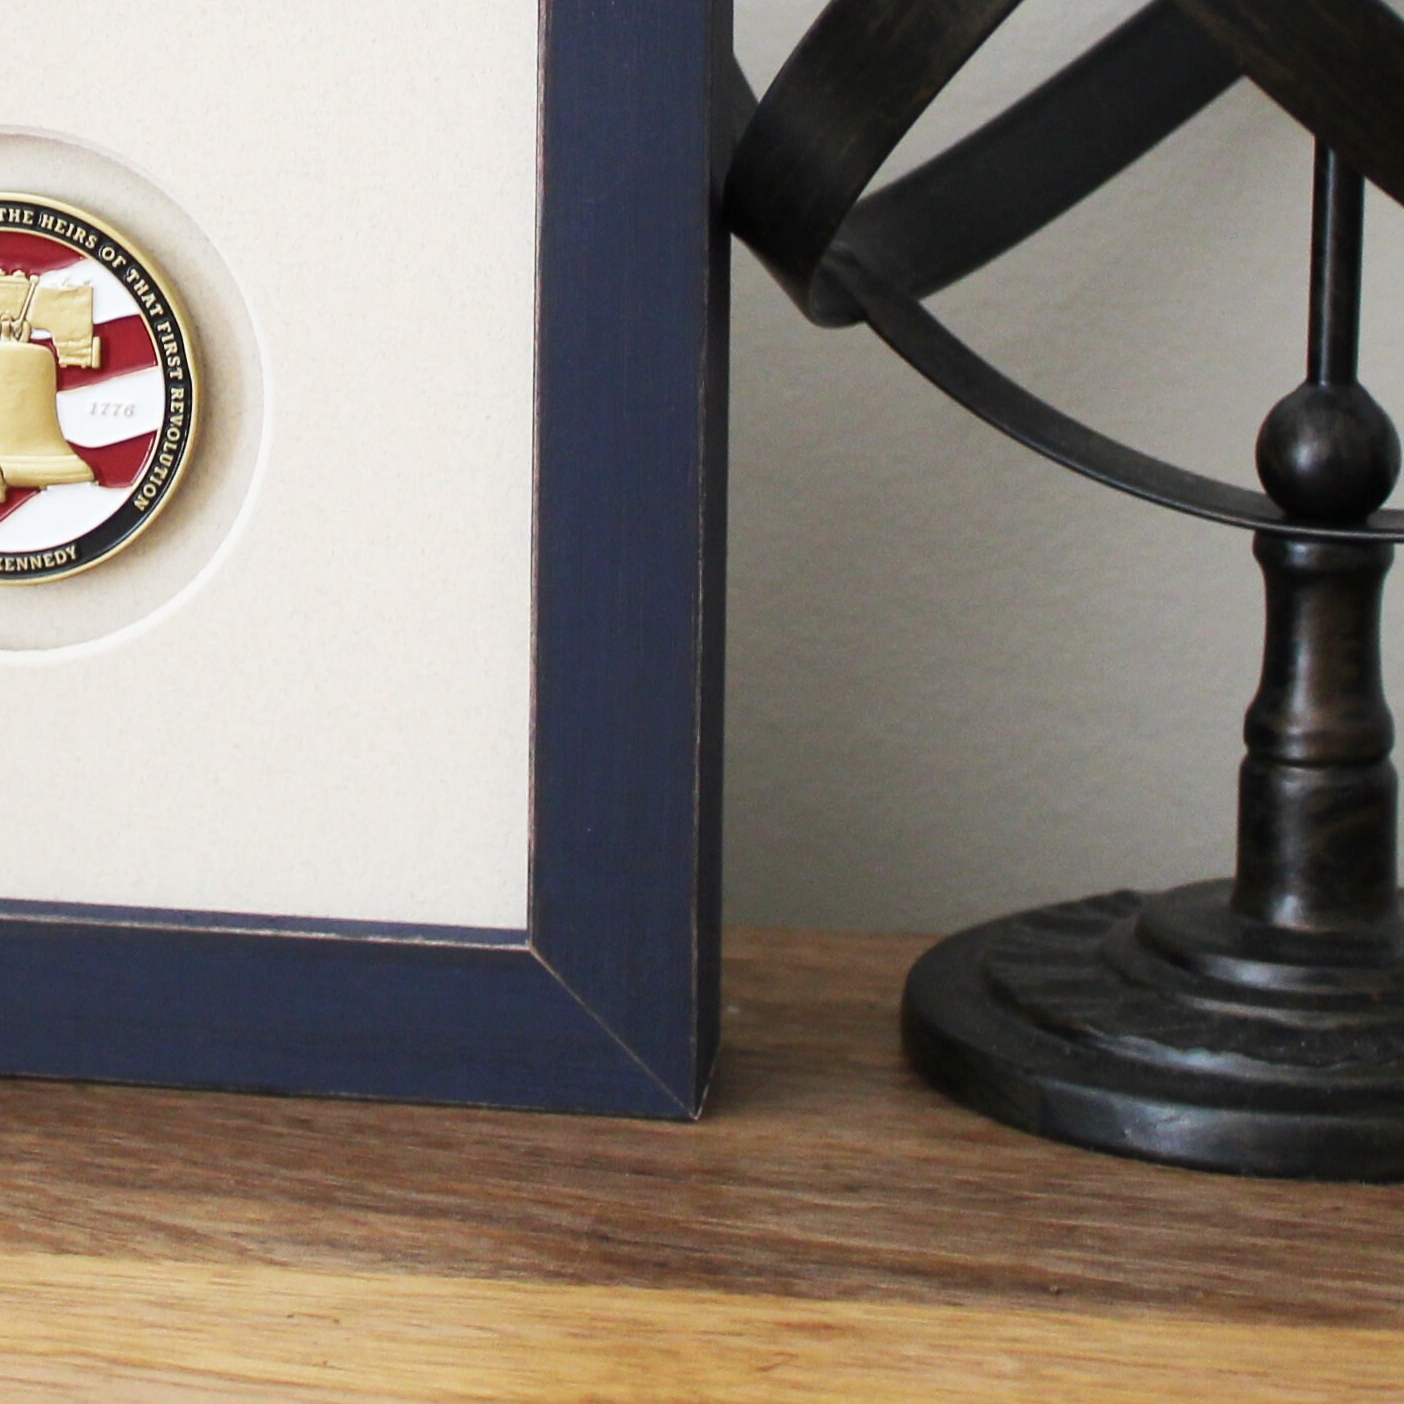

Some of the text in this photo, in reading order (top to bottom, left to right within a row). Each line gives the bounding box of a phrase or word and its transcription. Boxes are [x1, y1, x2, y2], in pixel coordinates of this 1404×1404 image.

[40, 213, 98, 249] HEIRS
[101, 246, 127, 269] OF
[126, 268, 164, 317] THAT
[157, 320, 183, 380] FIRST
[89, 402, 137, 419] 1776
[134, 387, 184, 511] REVOLUTION
